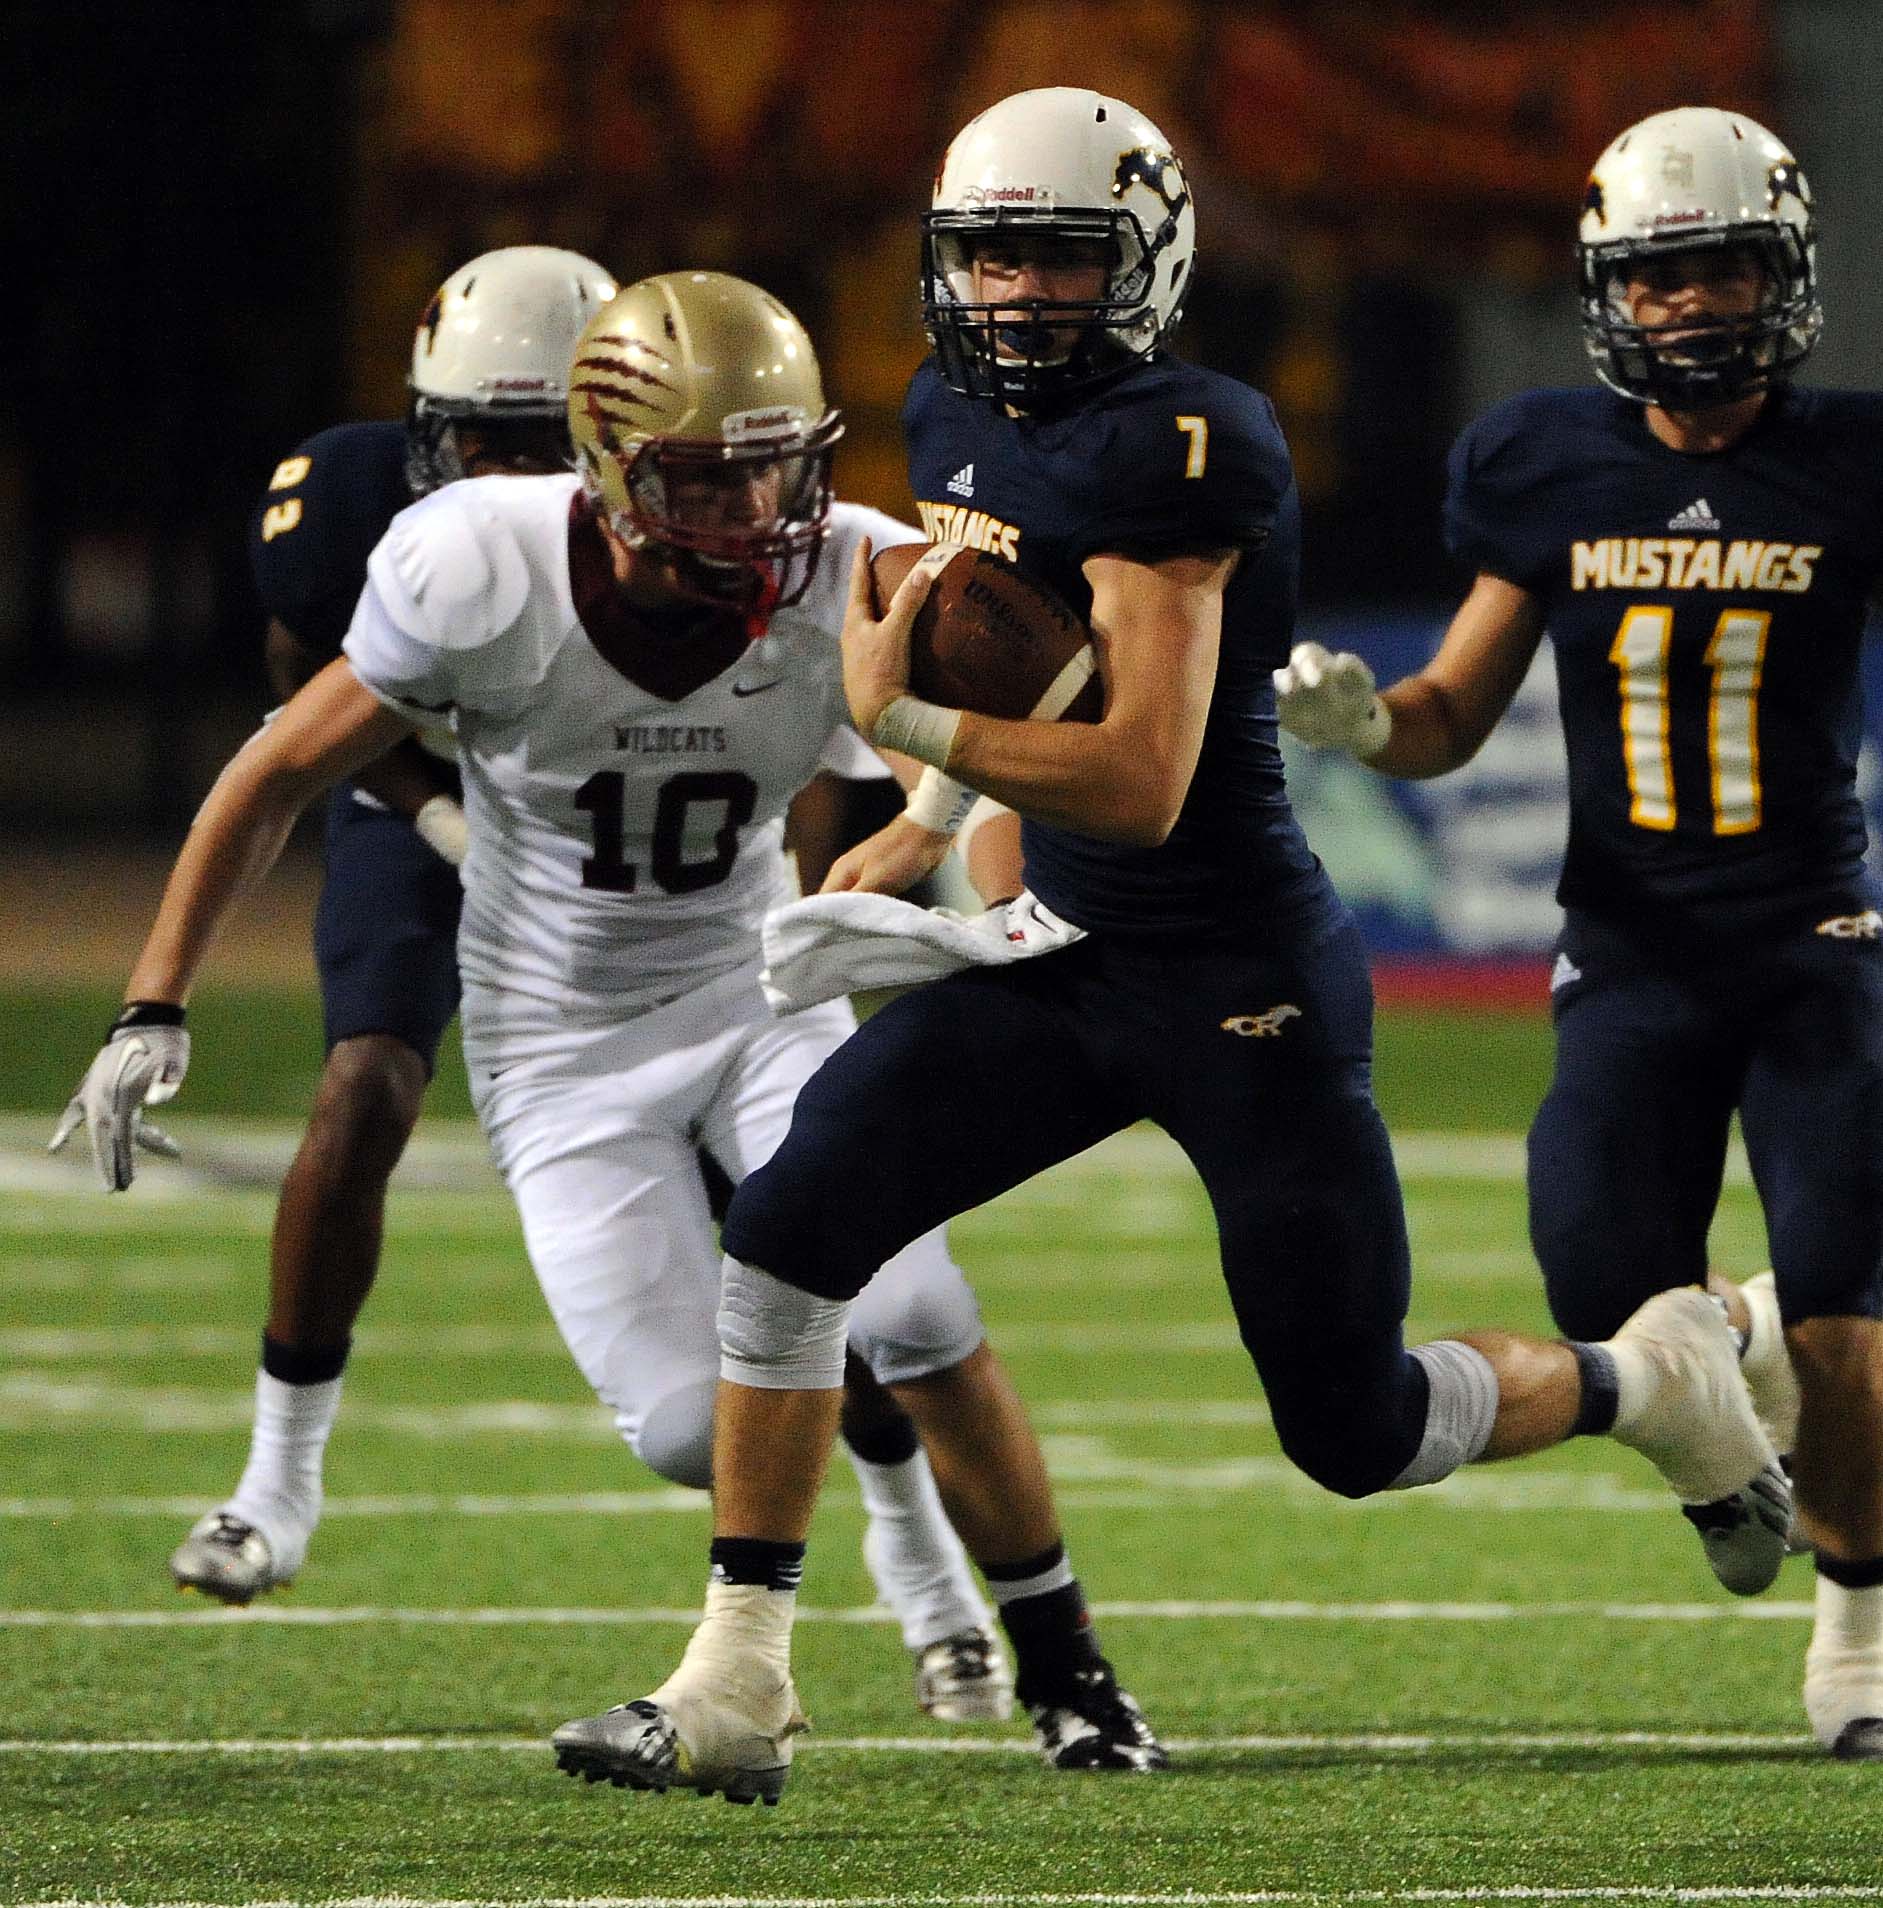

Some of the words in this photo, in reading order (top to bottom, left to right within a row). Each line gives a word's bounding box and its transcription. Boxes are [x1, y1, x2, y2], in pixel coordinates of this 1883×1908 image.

[1175, 415, 1209, 479] 7
[916, 501, 1020, 563] USTANGS
[1570, 537, 1823, 593] MUSTANGS
[614, 726, 727, 753] WILDCATS
[1607, 604, 1773, 836] 11
[573, 770, 759, 896] 10
